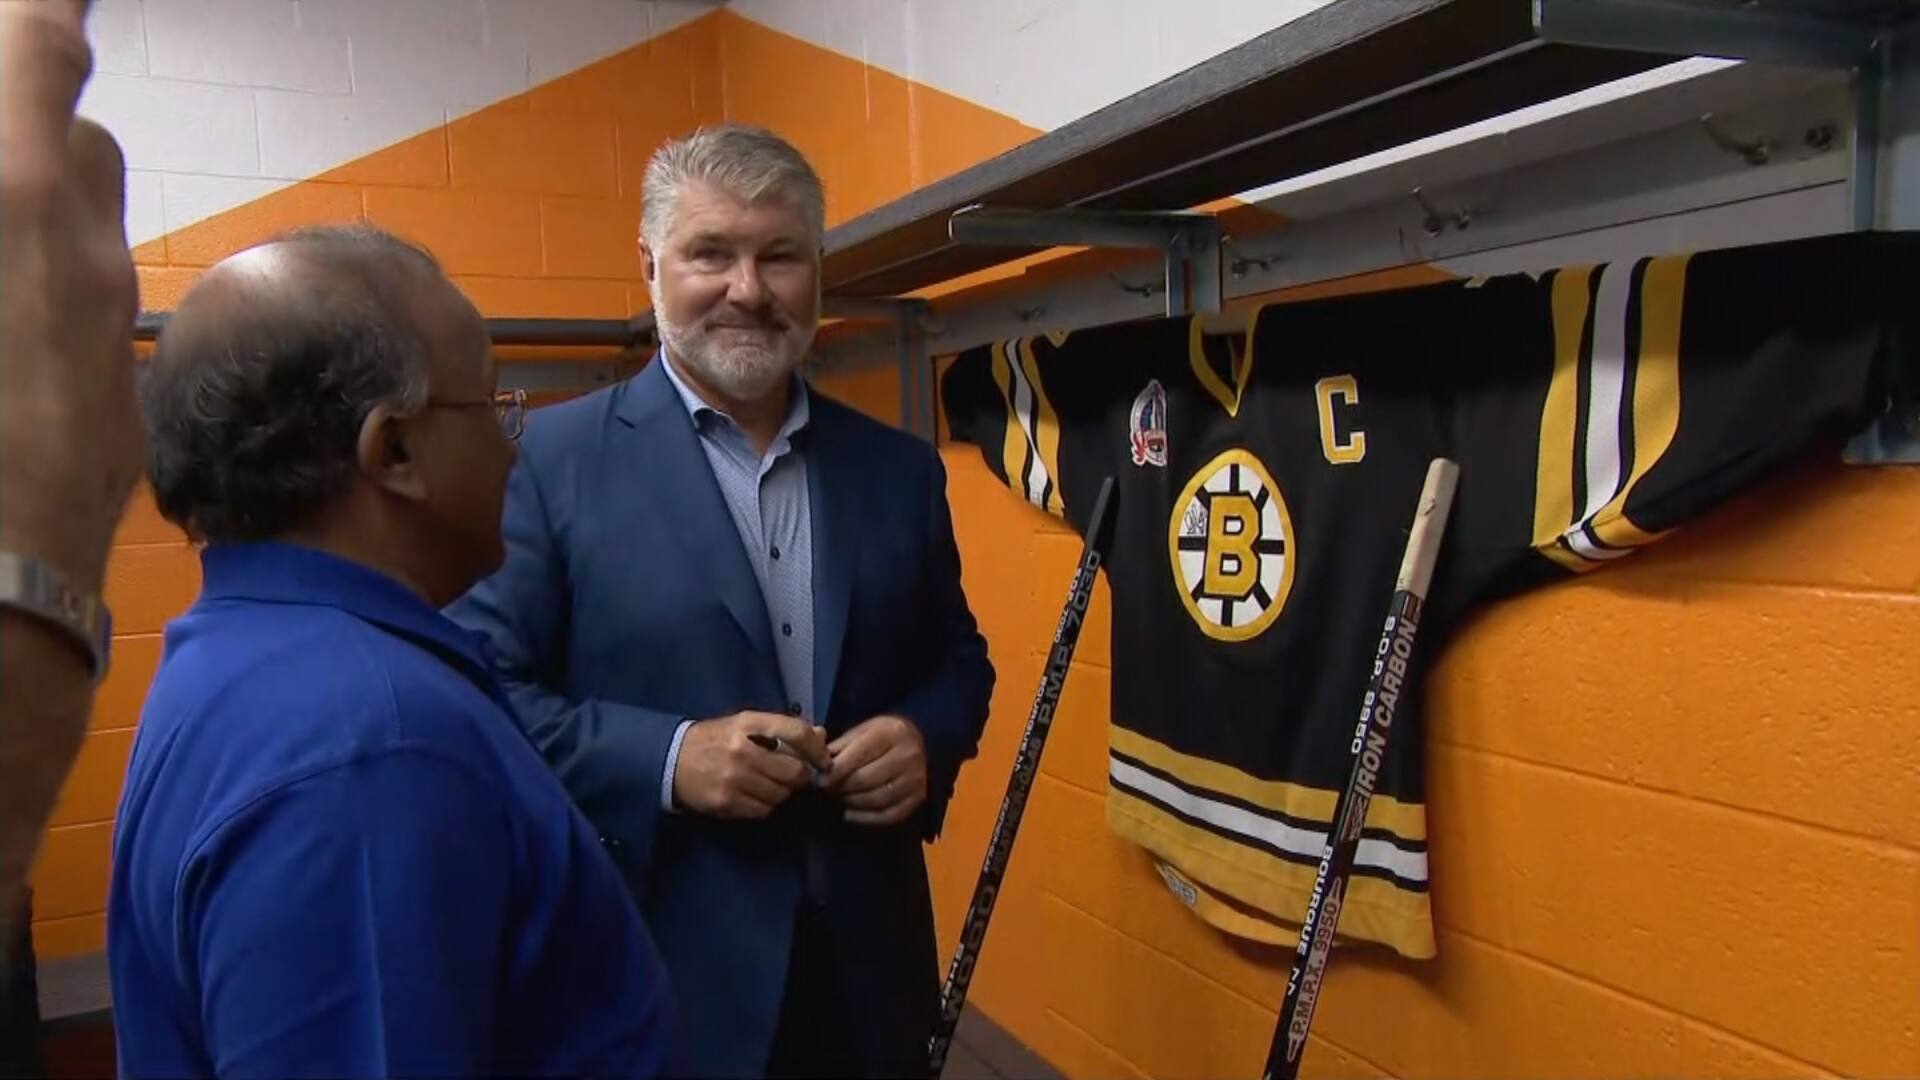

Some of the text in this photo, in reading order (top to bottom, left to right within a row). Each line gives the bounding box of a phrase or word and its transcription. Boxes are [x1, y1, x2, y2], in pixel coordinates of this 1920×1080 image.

[1315, 373, 1366, 465] C
[1067, 551, 1100, 628] 7030
[1203, 493, 1261, 600] B
[1021, 676, 1048, 751] BOURQUE
[1351, 616, 1396, 754] S.O.P. 9950
[1354, 618, 1417, 798] IRON CARBON
[1297, 845, 1333, 955] BOURQUE
[1313, 901, 1338, 951] 9950
